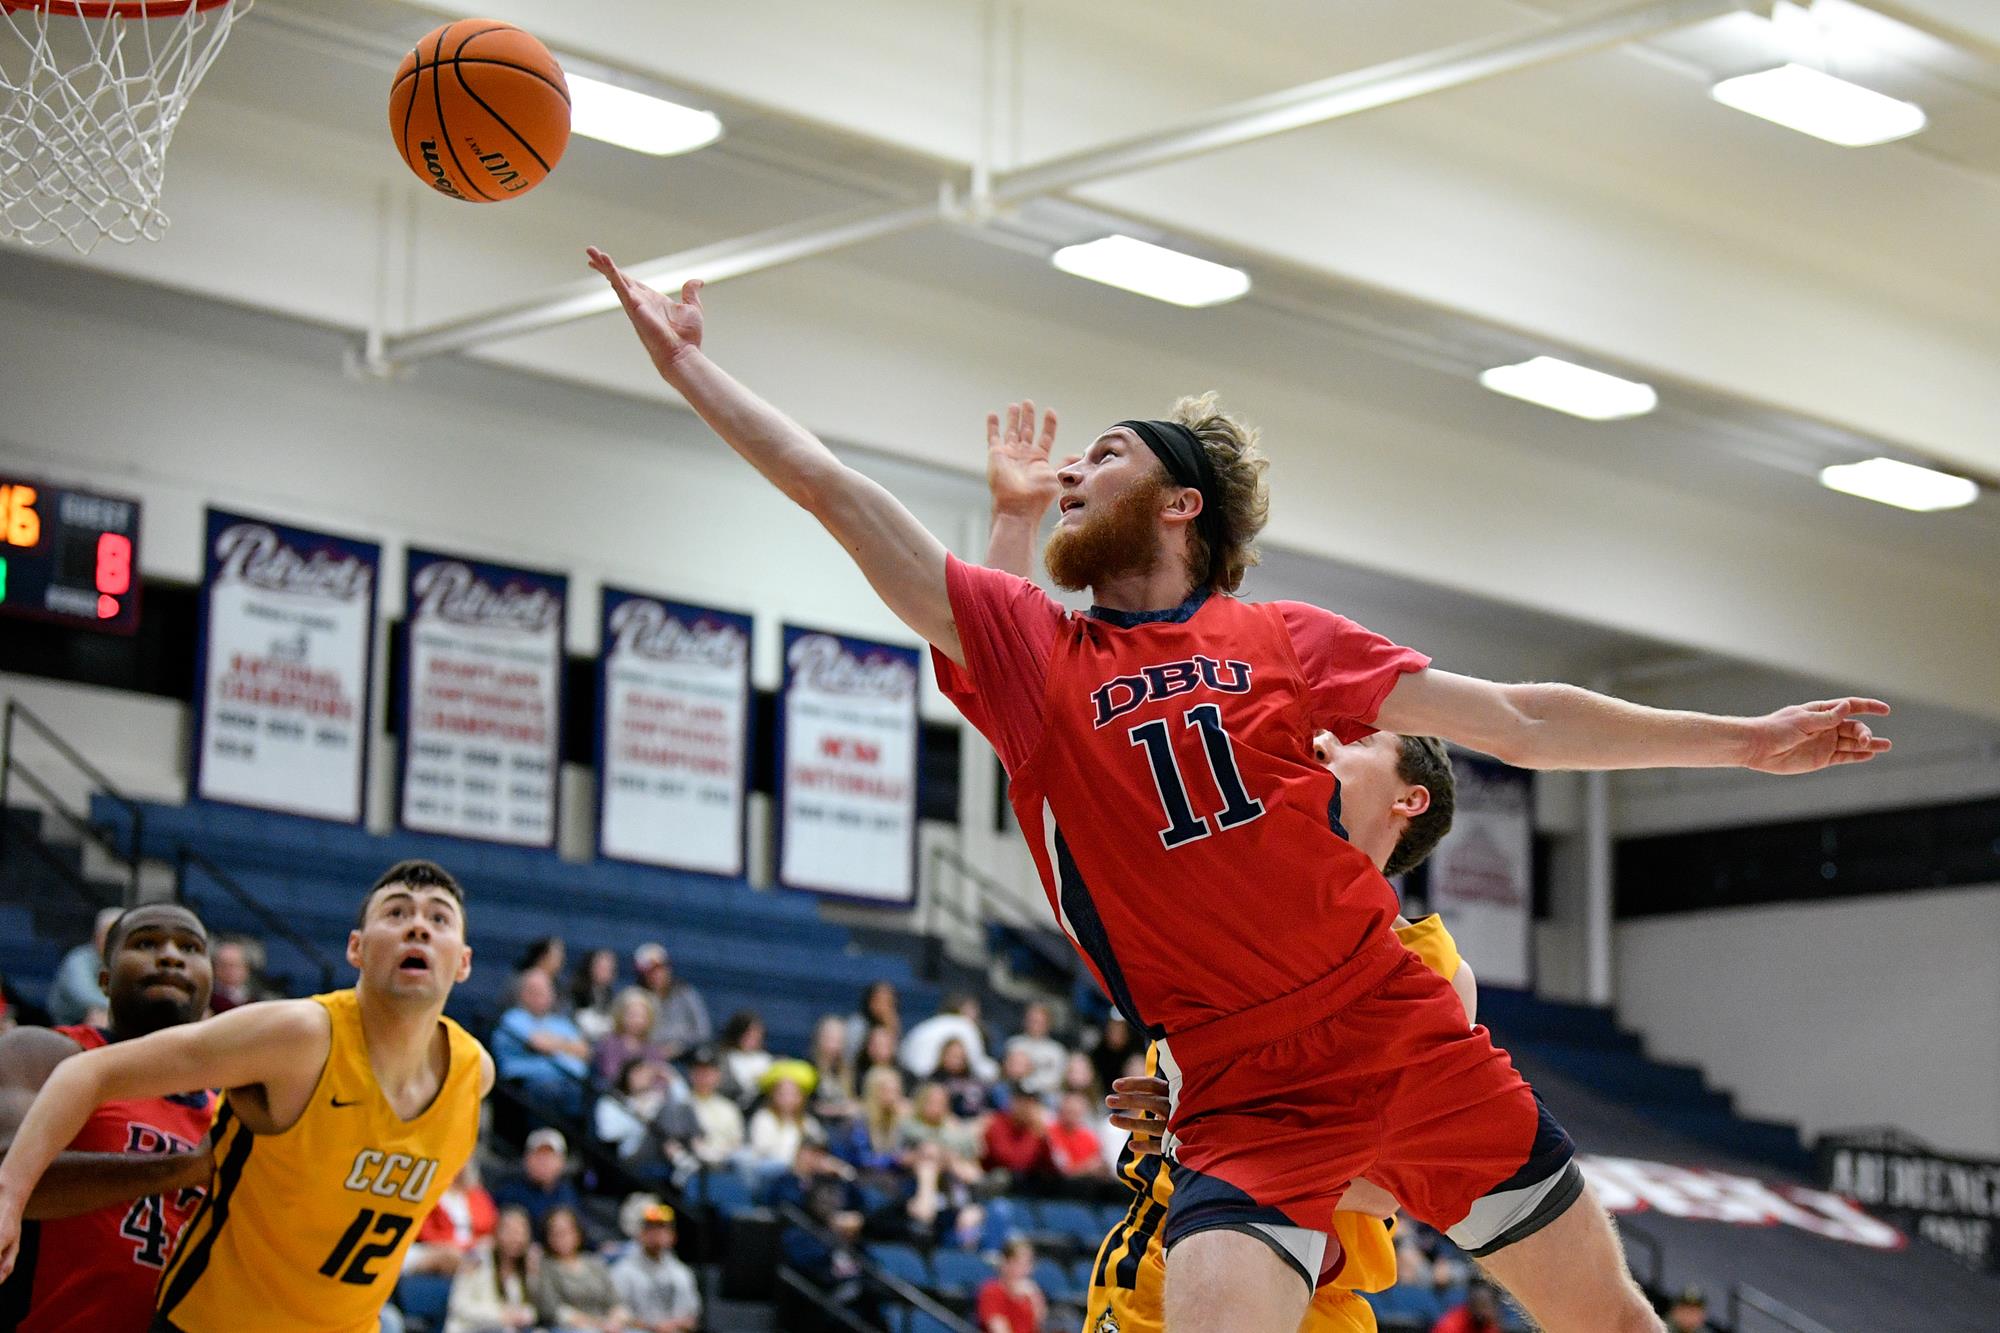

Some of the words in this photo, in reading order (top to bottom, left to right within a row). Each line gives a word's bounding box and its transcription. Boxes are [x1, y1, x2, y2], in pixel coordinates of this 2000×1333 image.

[1091, 655, 1252, 730] DBU
[1128, 703, 1266, 850] 11
[344, 1149, 439, 1203] CCU
[319, 1208, 413, 1286] 12
